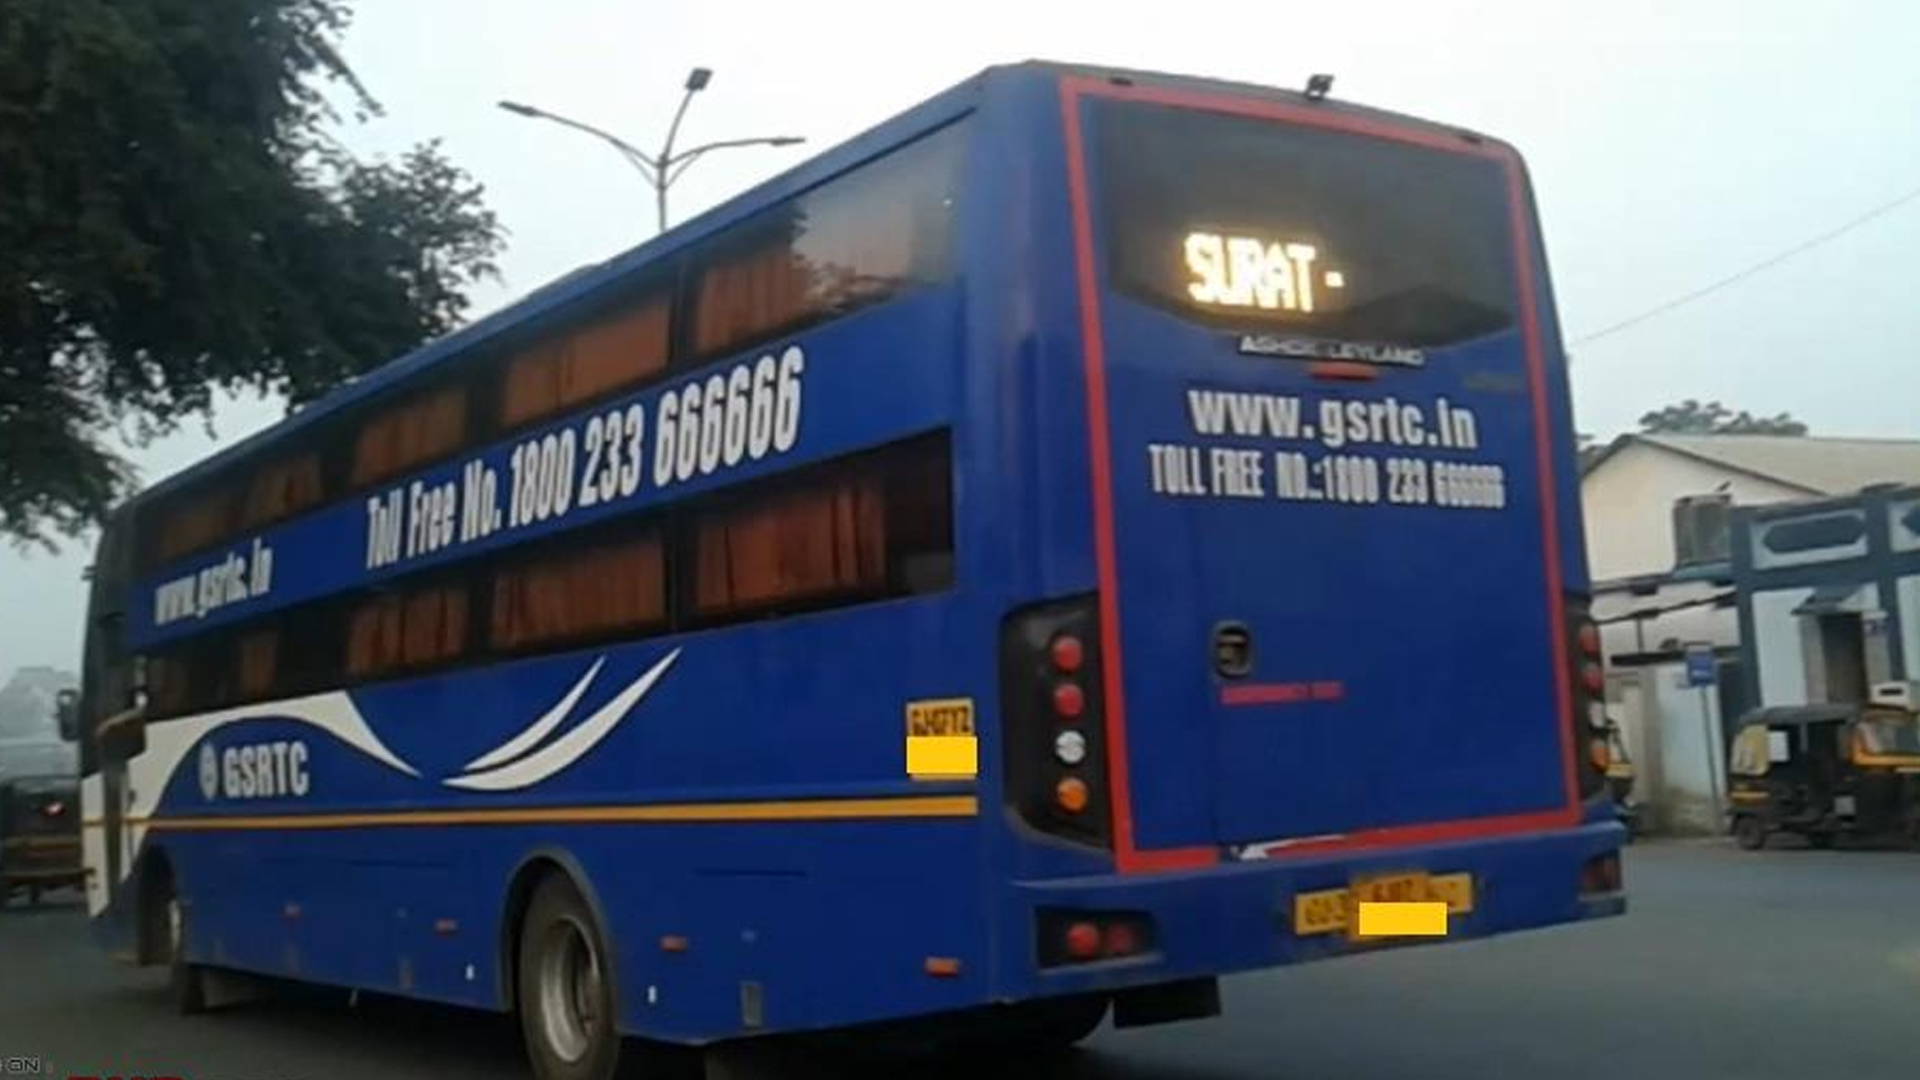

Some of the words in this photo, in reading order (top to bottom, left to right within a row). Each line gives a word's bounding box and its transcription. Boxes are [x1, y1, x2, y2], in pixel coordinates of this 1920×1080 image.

[1184, 233, 1315, 311] SURAT
[1330, 343, 1424, 364] LEYLAND
[1189, 389, 1477, 448] www.gsrtc.in
[367, 495, 402, 569] Toll
[408, 480, 456, 558] Free
[461, 460, 501, 542] No.
[510, 429, 576, 527] 1800
[579, 403, 644, 506] 233
[654, 347, 804, 486] 666666
[1149, 445, 1204, 494] TOLL
[1213, 449, 1264, 497] FREE
[1387, 457, 1427, 504] 233
[223, 742, 309, 798] GSRTC
